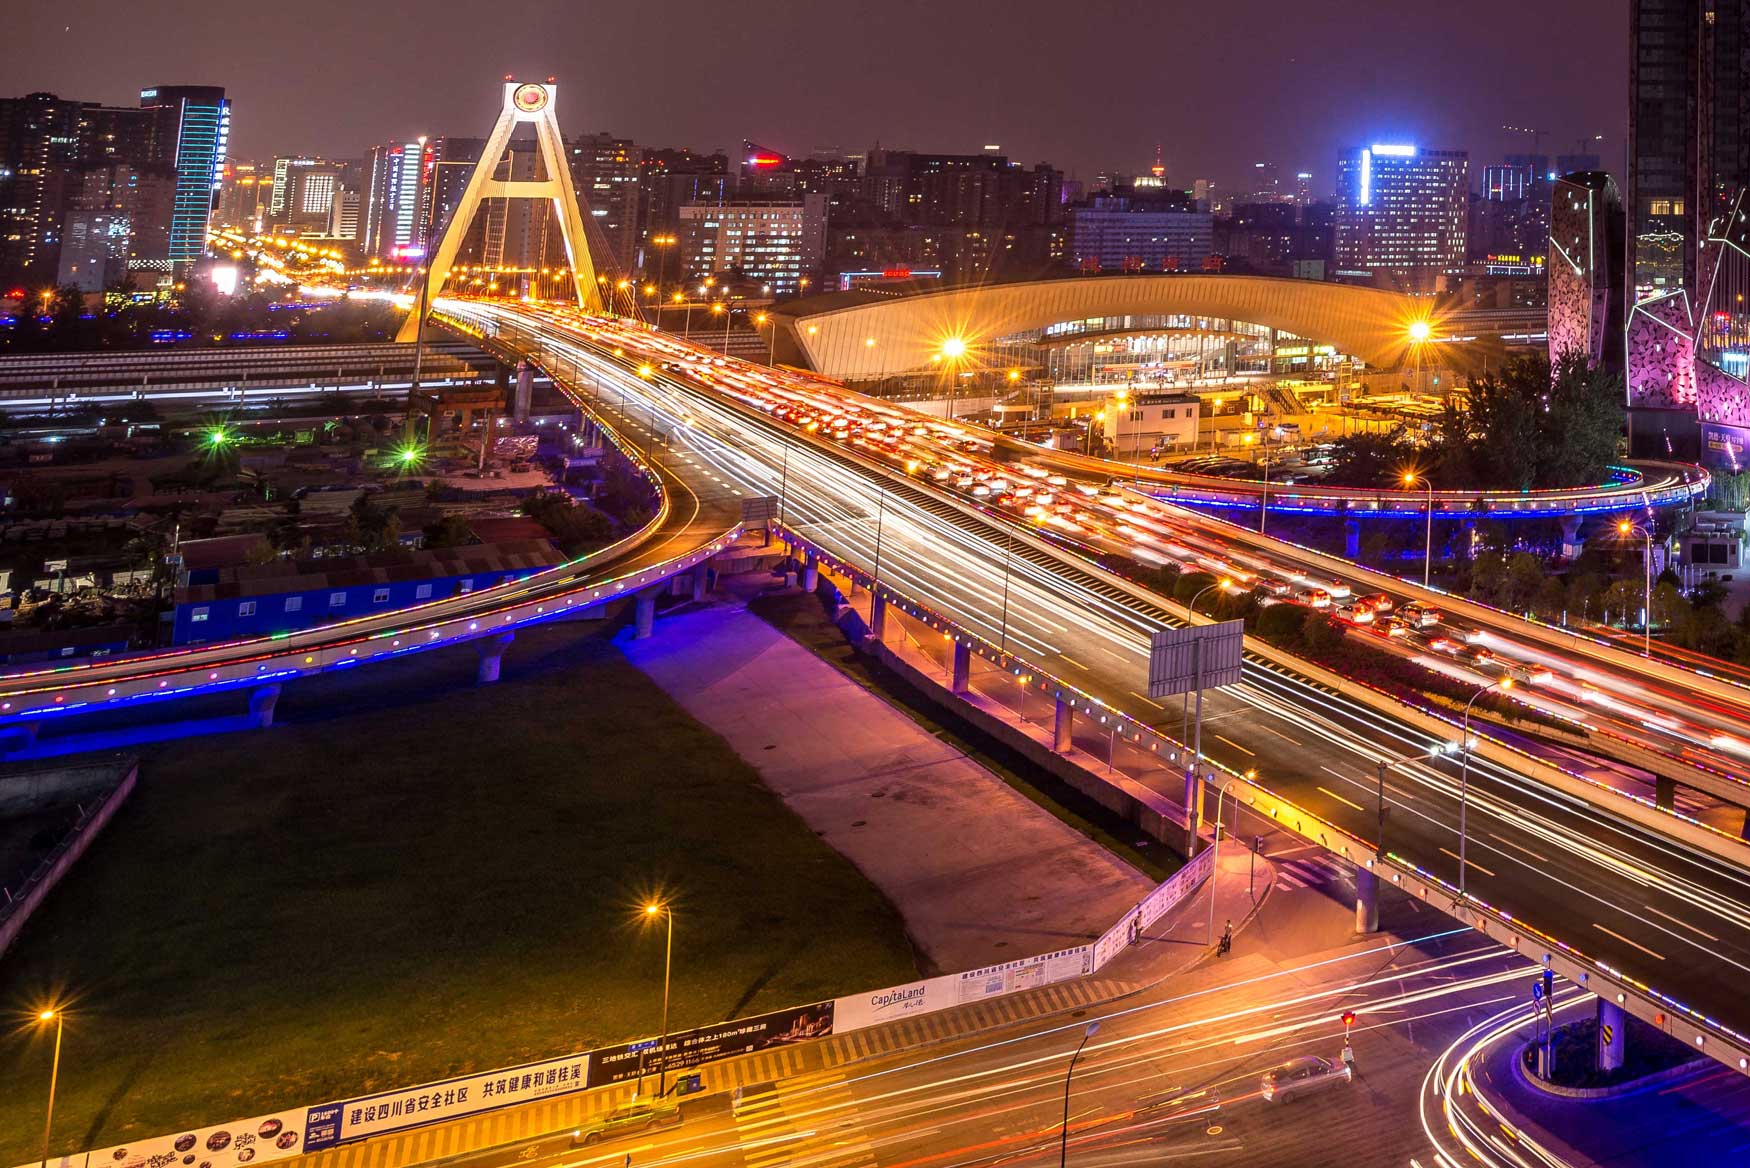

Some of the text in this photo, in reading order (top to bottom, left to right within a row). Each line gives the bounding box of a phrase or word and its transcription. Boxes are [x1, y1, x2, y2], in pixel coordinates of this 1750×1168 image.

[871, 986, 925, 1005] CapitaLand
[350, 1088, 469, 1126] 建设四川省安全社区
[483, 1064, 581, 1098] 共筑健康和谐桂溪
